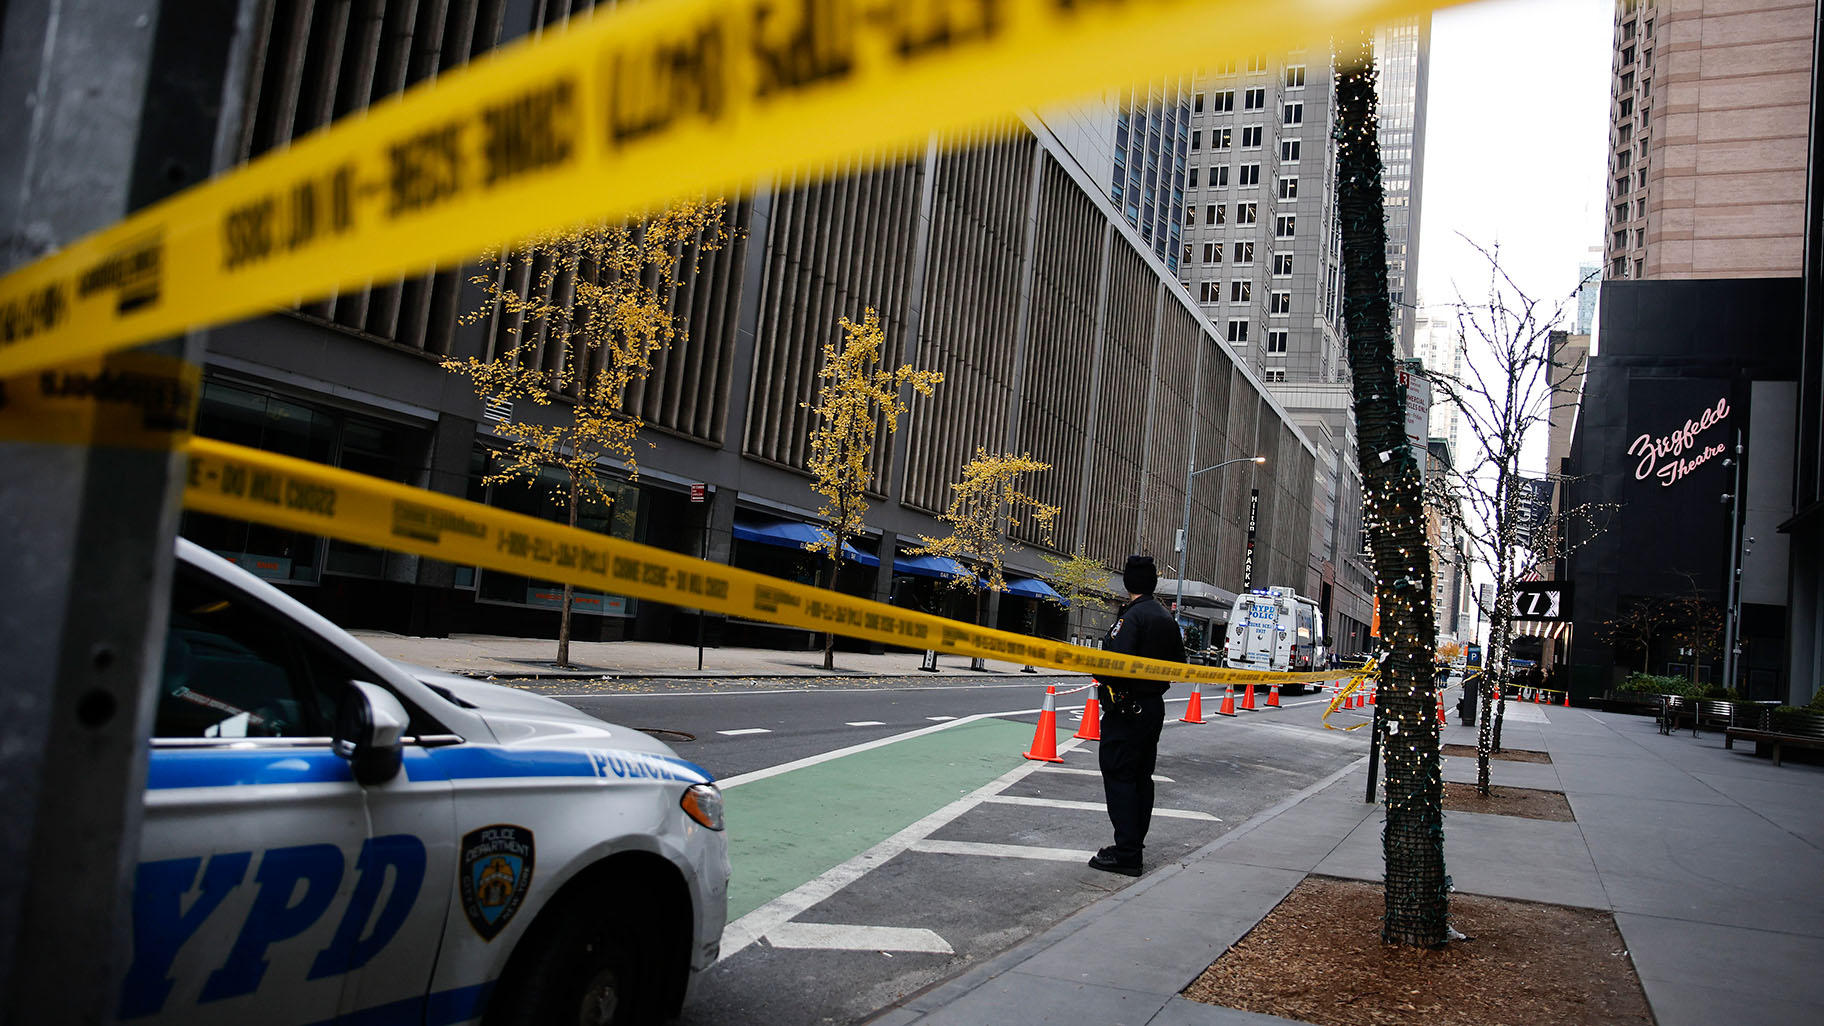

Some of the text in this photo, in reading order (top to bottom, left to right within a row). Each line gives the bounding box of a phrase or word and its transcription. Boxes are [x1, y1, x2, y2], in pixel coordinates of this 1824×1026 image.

[1402, 373, 1408, 385] 3
[1407, 394, 1425, 406] MERCIAL
[1627, 397, 1731, 480] Ziegfeld
[1656, 443, 1726, 487] Theatre
[1249, 496, 1258, 532] Hilton
[1244, 549, 1253, 580] PARK
[1251, 604, 1275, 614] NYPD
[1527, 592, 1541, 615] Z
[1249, 611, 1276, 620] POLIC
[1471, 652, 1478, 660] P
[482, 828, 516, 842] POLICE
[465, 840, 530, 863] DEPARTMENT
[118, 834, 428, 1021] YPD
